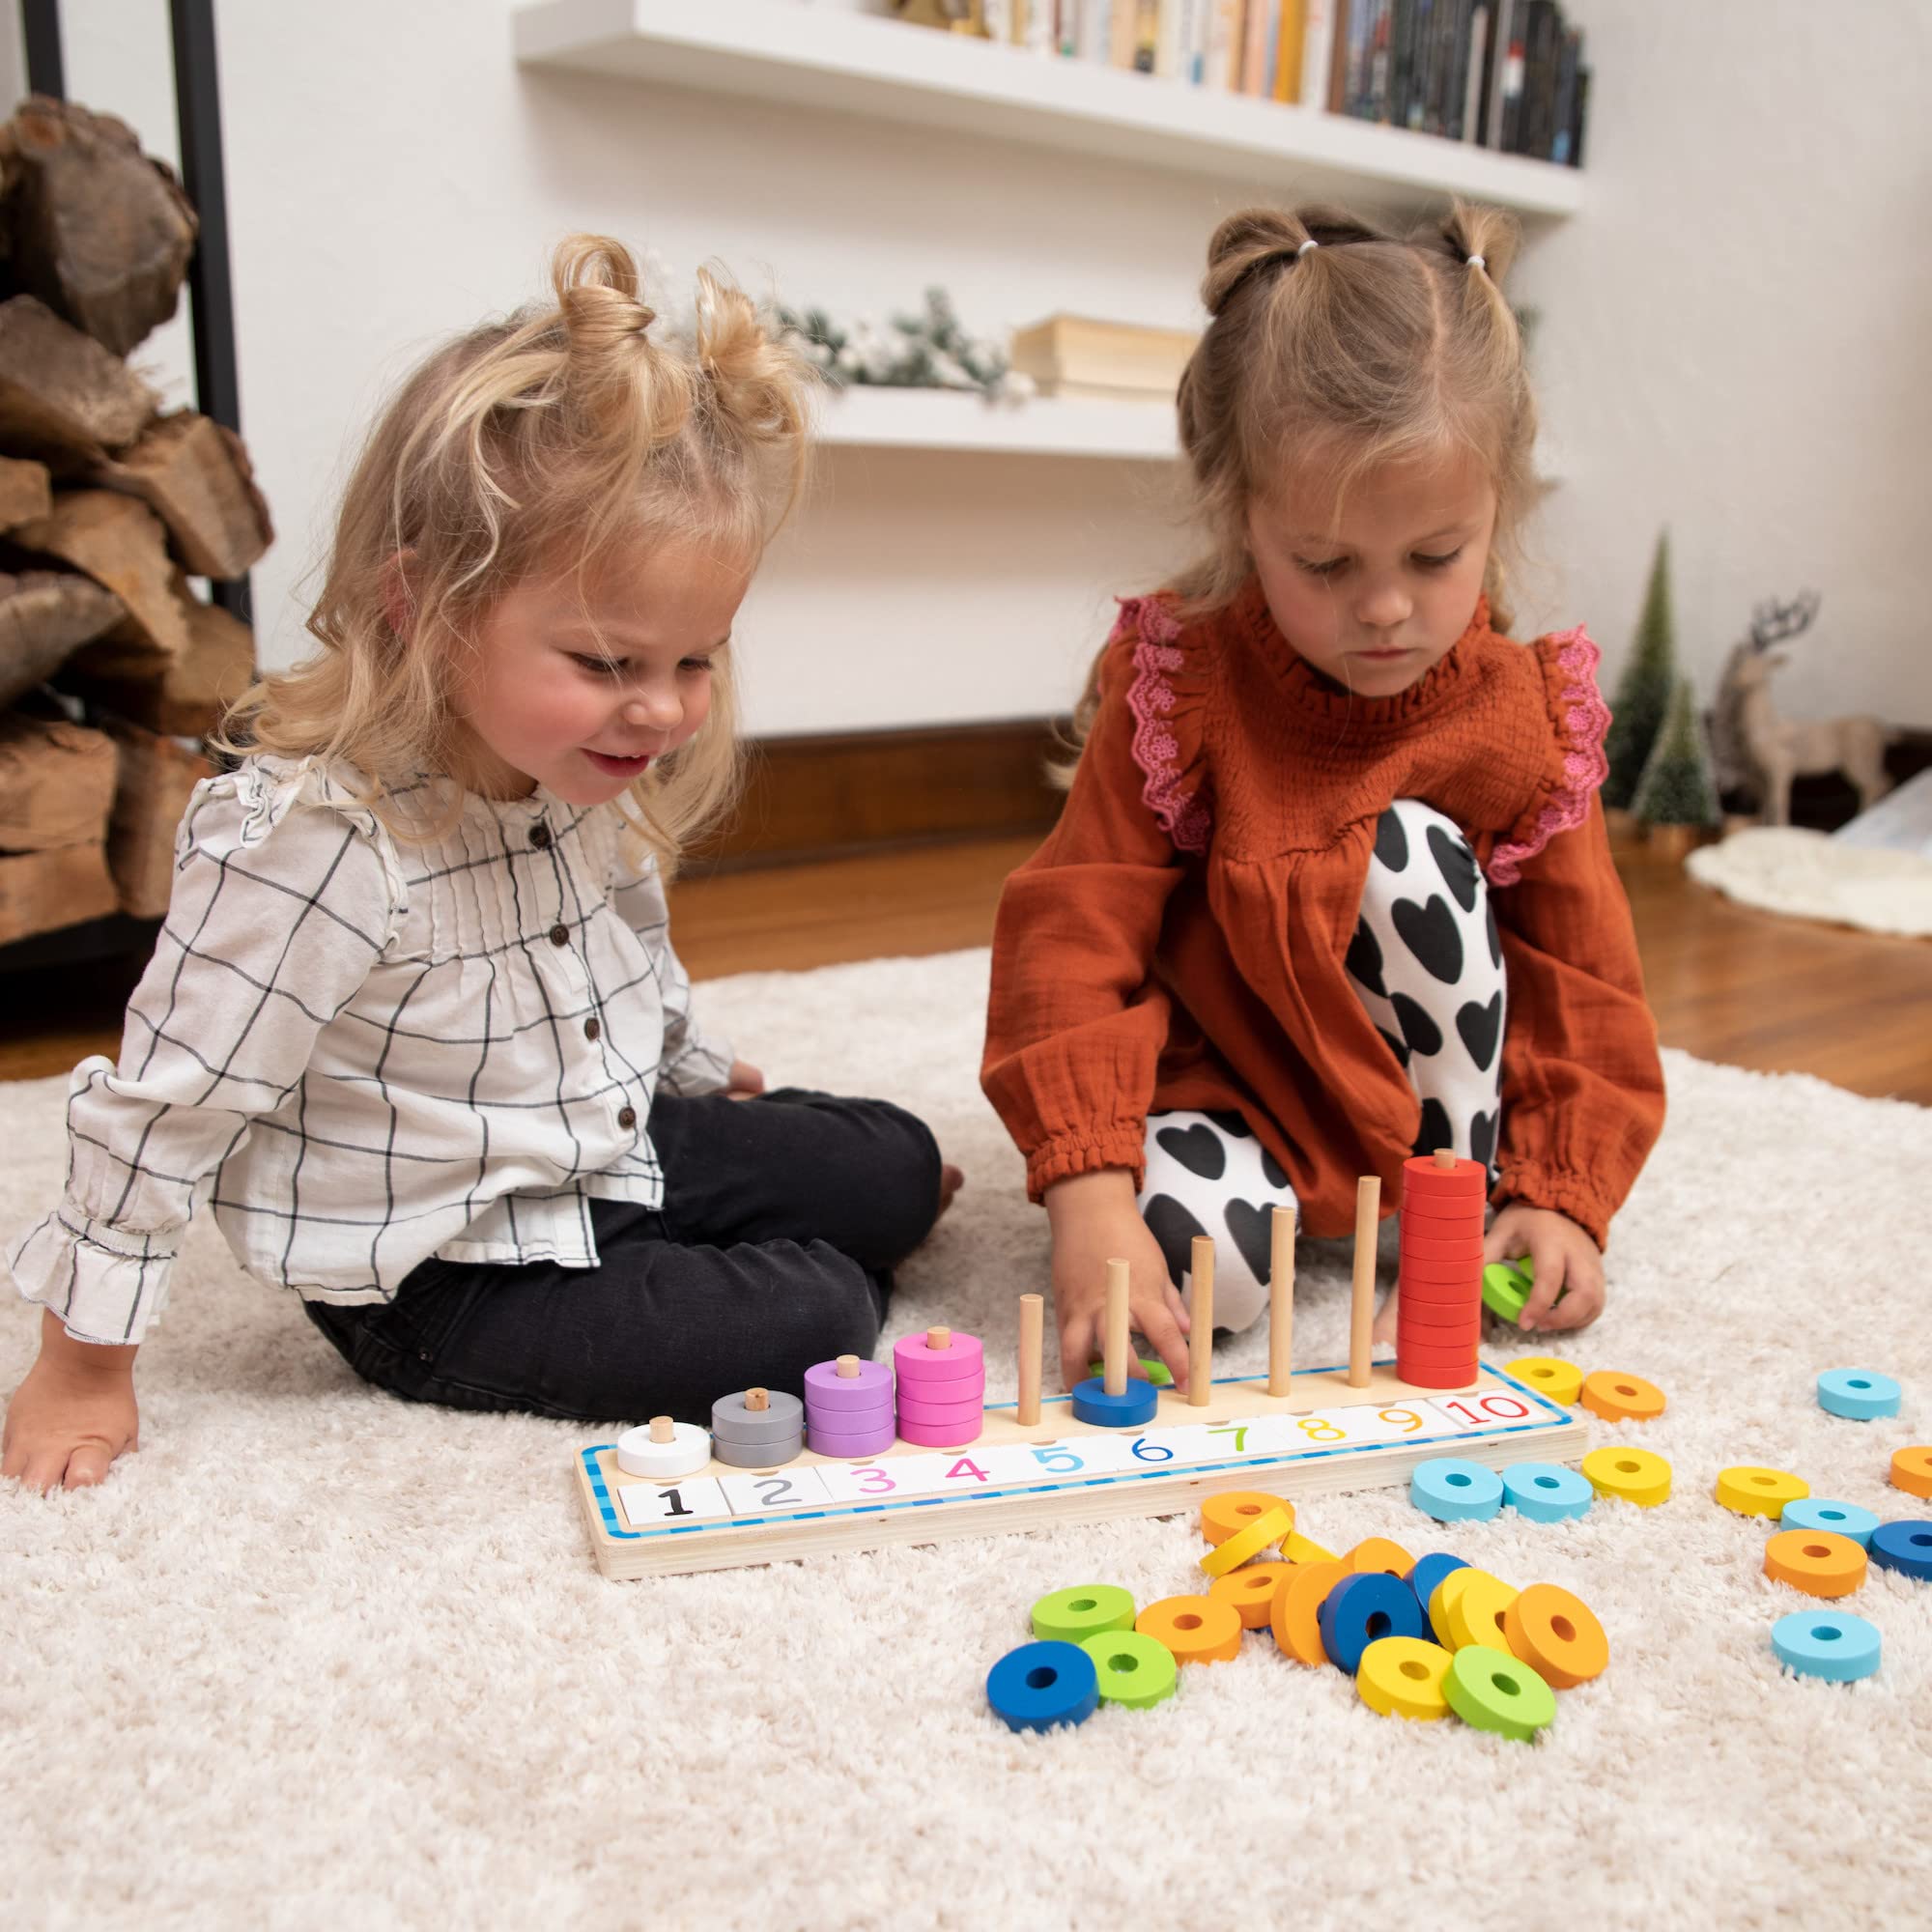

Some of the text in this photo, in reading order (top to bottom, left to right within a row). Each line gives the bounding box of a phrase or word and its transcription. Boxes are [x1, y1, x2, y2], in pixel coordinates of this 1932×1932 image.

[657, 1396, 1530, 1516] 1 2 3 4 5 6 7 8 9 10
